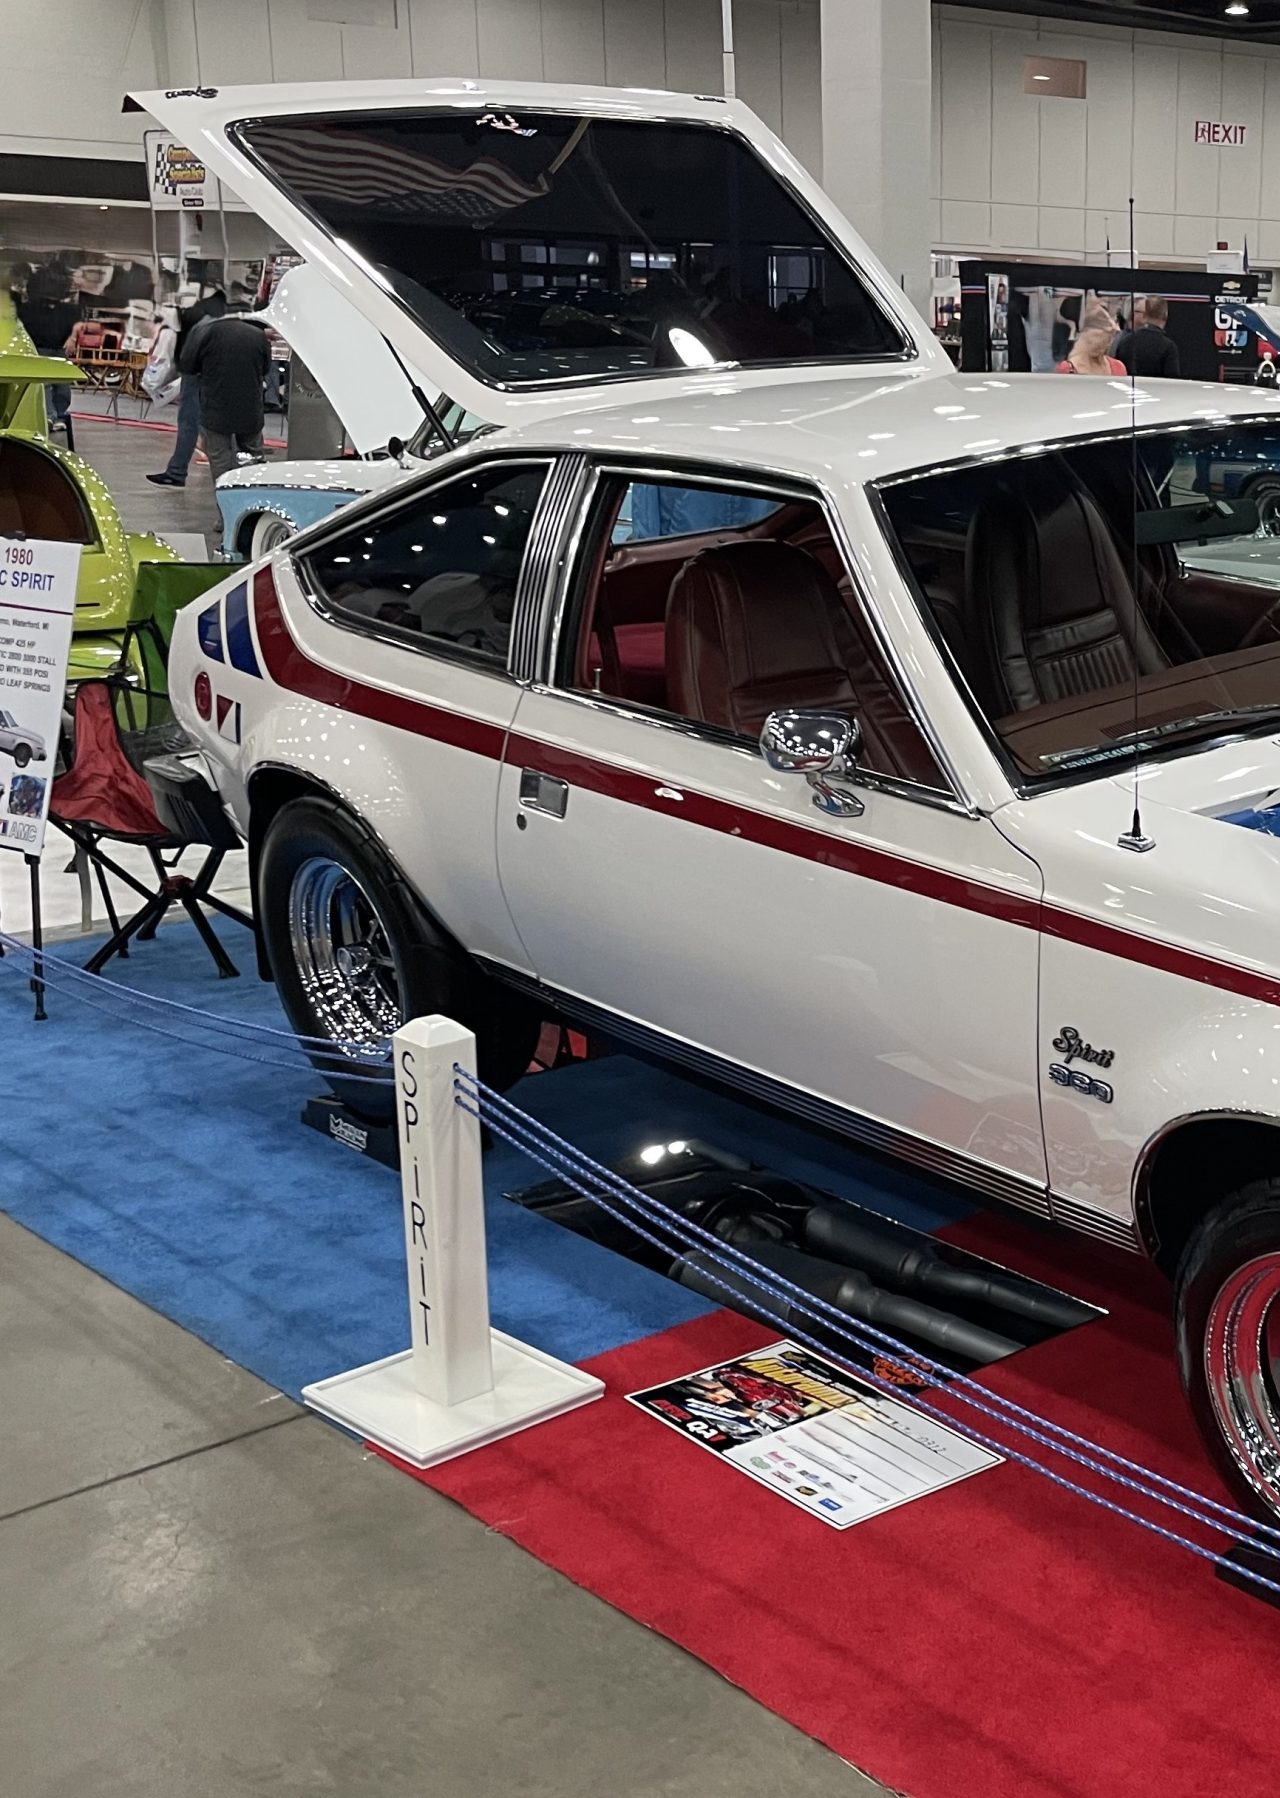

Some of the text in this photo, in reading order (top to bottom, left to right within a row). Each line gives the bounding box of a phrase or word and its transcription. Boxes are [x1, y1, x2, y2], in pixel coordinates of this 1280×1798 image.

[1212, 123, 1246, 144] EXIT
[1214, 295, 1248, 303] DETROIT
[5, 547, 33, 566] 1980
[11, 570, 55, 592] SPIRIT
[37, 655, 56, 667] STALL
[23, 680, 51, 693] SPRINGS
[1052, 1026, 1115, 1069] Spirit
